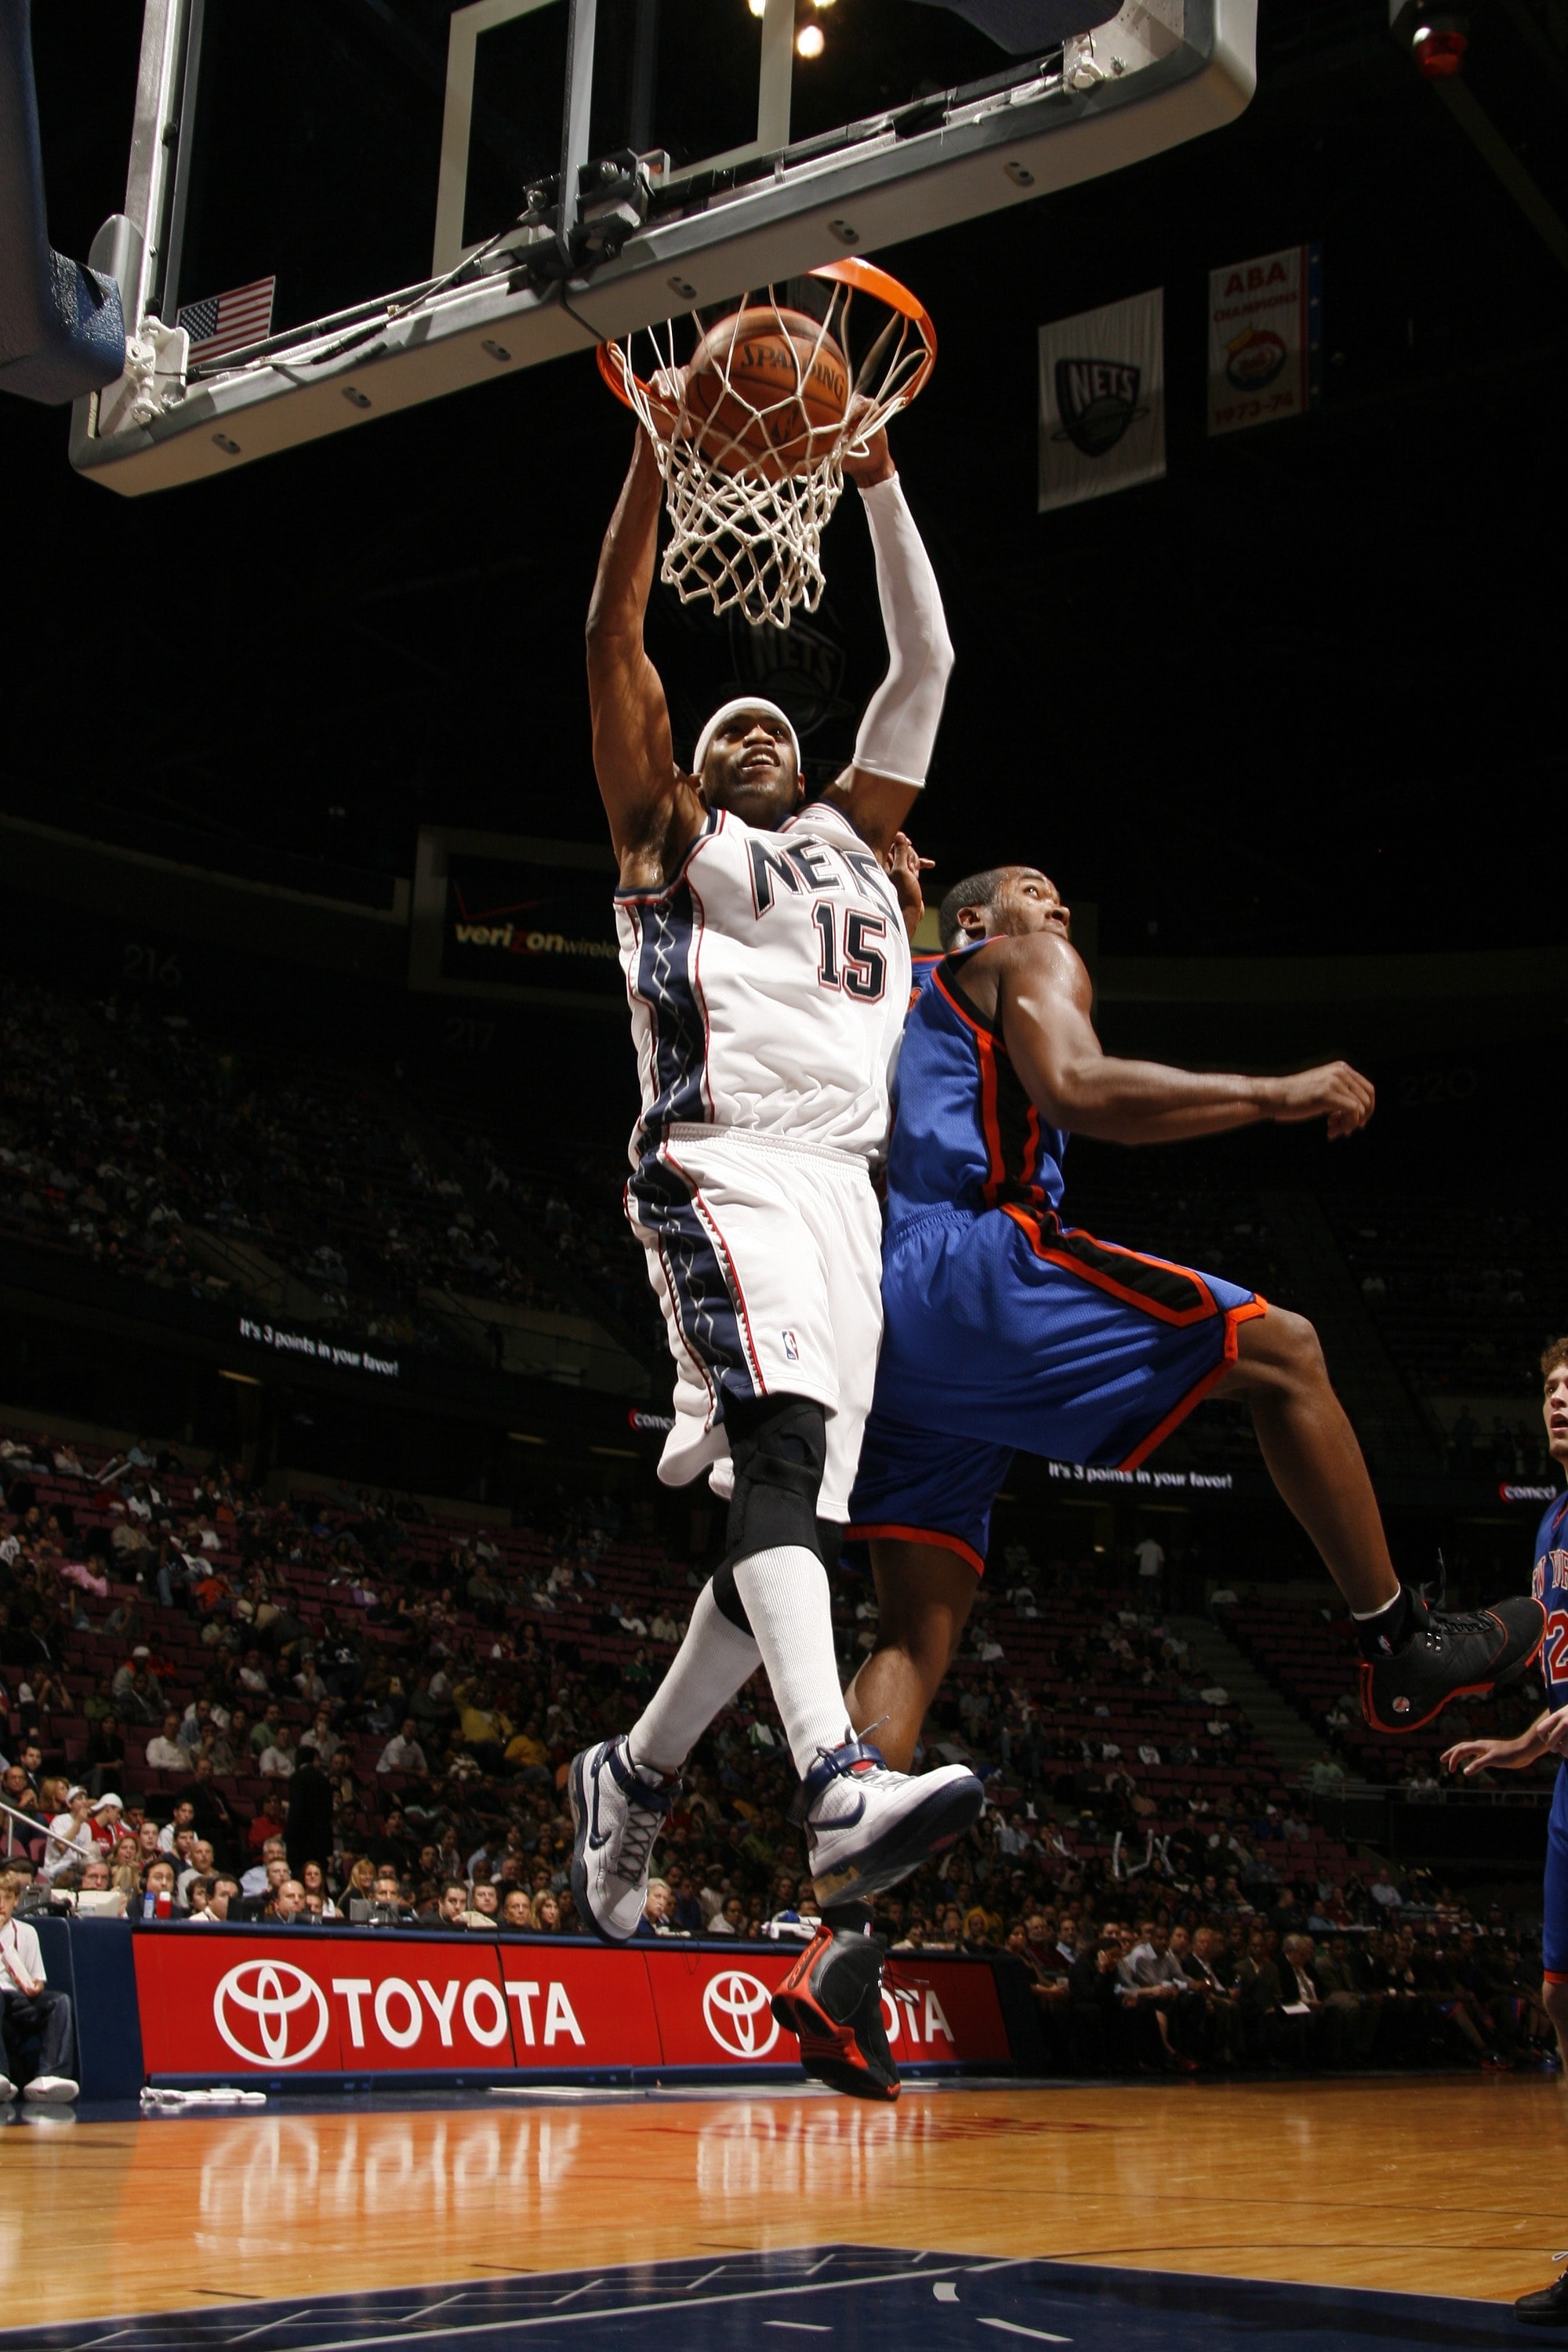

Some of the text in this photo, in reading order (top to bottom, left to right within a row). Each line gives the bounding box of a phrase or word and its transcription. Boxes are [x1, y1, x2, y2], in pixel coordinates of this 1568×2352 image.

[1225, 262, 1286, 297] ABA
[1067, 361, 1137, 418] NETS
[1214, 391, 1294, 426] 1973-74
[745, 833, 903, 937] NES
[454, 922, 565, 956] verizon
[811, 899, 887, 1004] 15
[238, 1316, 401, 1378] It's 3 points in your favor!
[1048, 1461, 1233, 1490] It's 3 points in your favor!
[332, 1976, 586, 2049] TOYOTA
